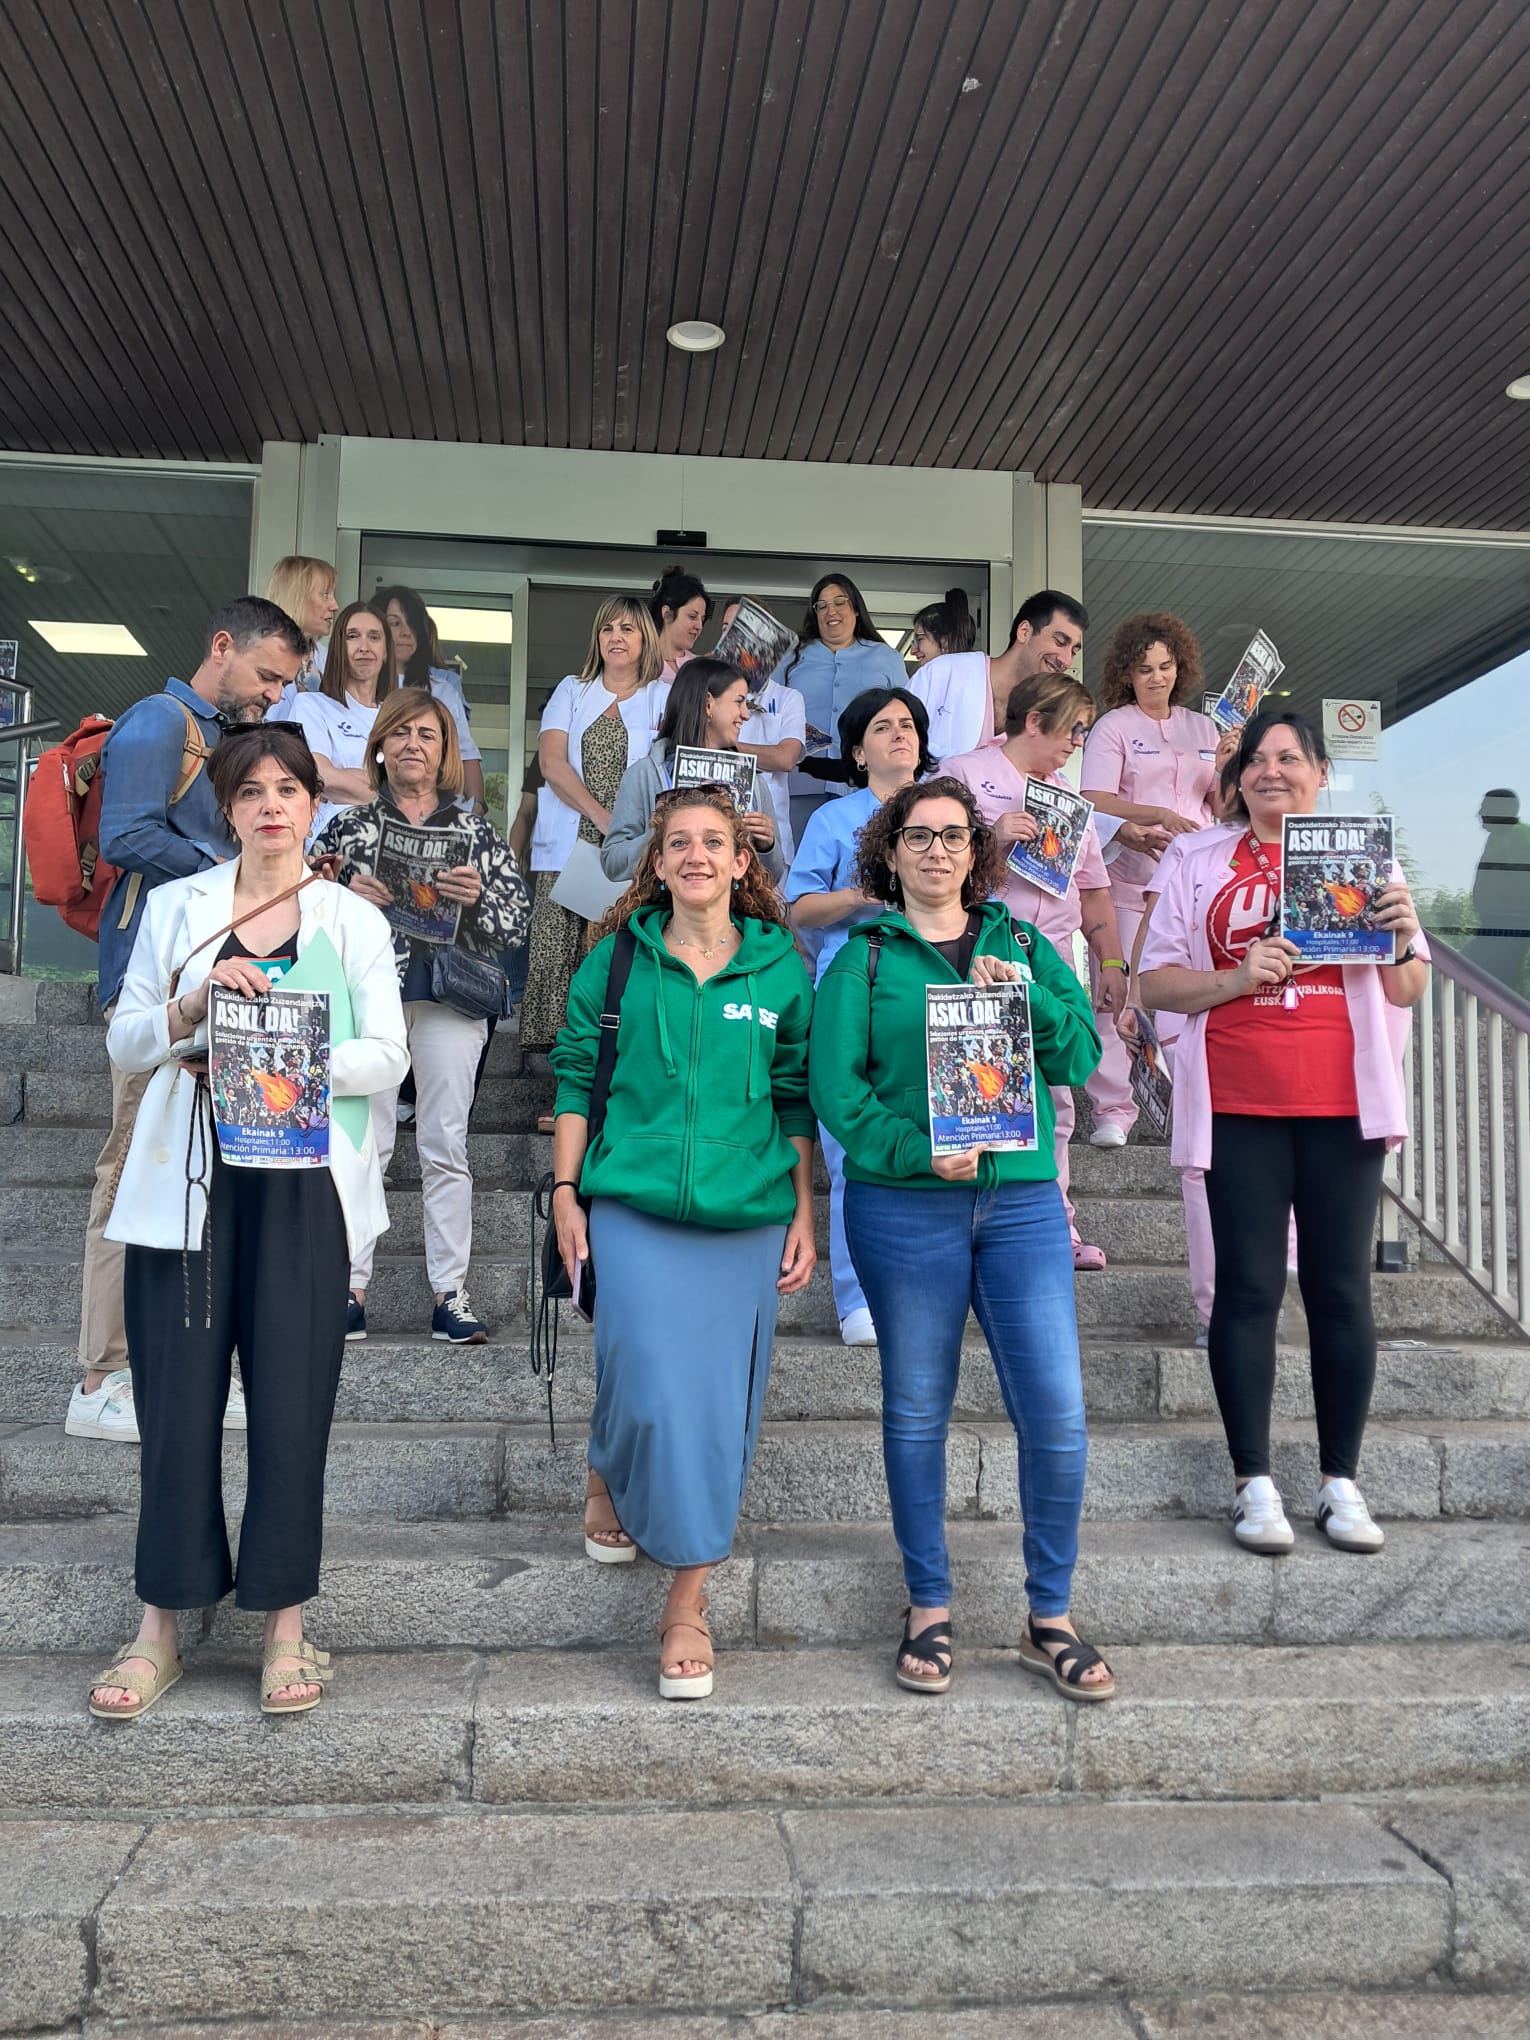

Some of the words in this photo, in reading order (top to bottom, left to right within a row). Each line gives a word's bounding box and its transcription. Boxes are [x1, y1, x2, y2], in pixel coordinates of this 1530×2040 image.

[678, 759, 710, 779] ASKI
[713, 763, 735, 782] DA!
[1027, 785, 1055, 806] ASKI
[384, 830, 420, 857] ASKI
[422, 840, 449, 858] DA!
[1288, 829, 1330, 851] ASKI
[1335, 829, 1366, 851] DA!
[1313, 931, 1346, 939] Ekainak
[1348, 931, 1354, 939] 9
[215, 1000, 259, 1031] ASKI
[265, 1005, 300, 1034] DA!
[723, 1003, 779, 1030] SASE
[928, 1001, 968, 1027] ASKI
[972, 1000, 1001, 1024] DA!
[215, 1031, 246, 1040] Soluciones
[961, 1115, 990, 1125] Ekainak
[242, 1127, 276, 1137] Ekainak
[937, 1133, 970, 1142] Atención
